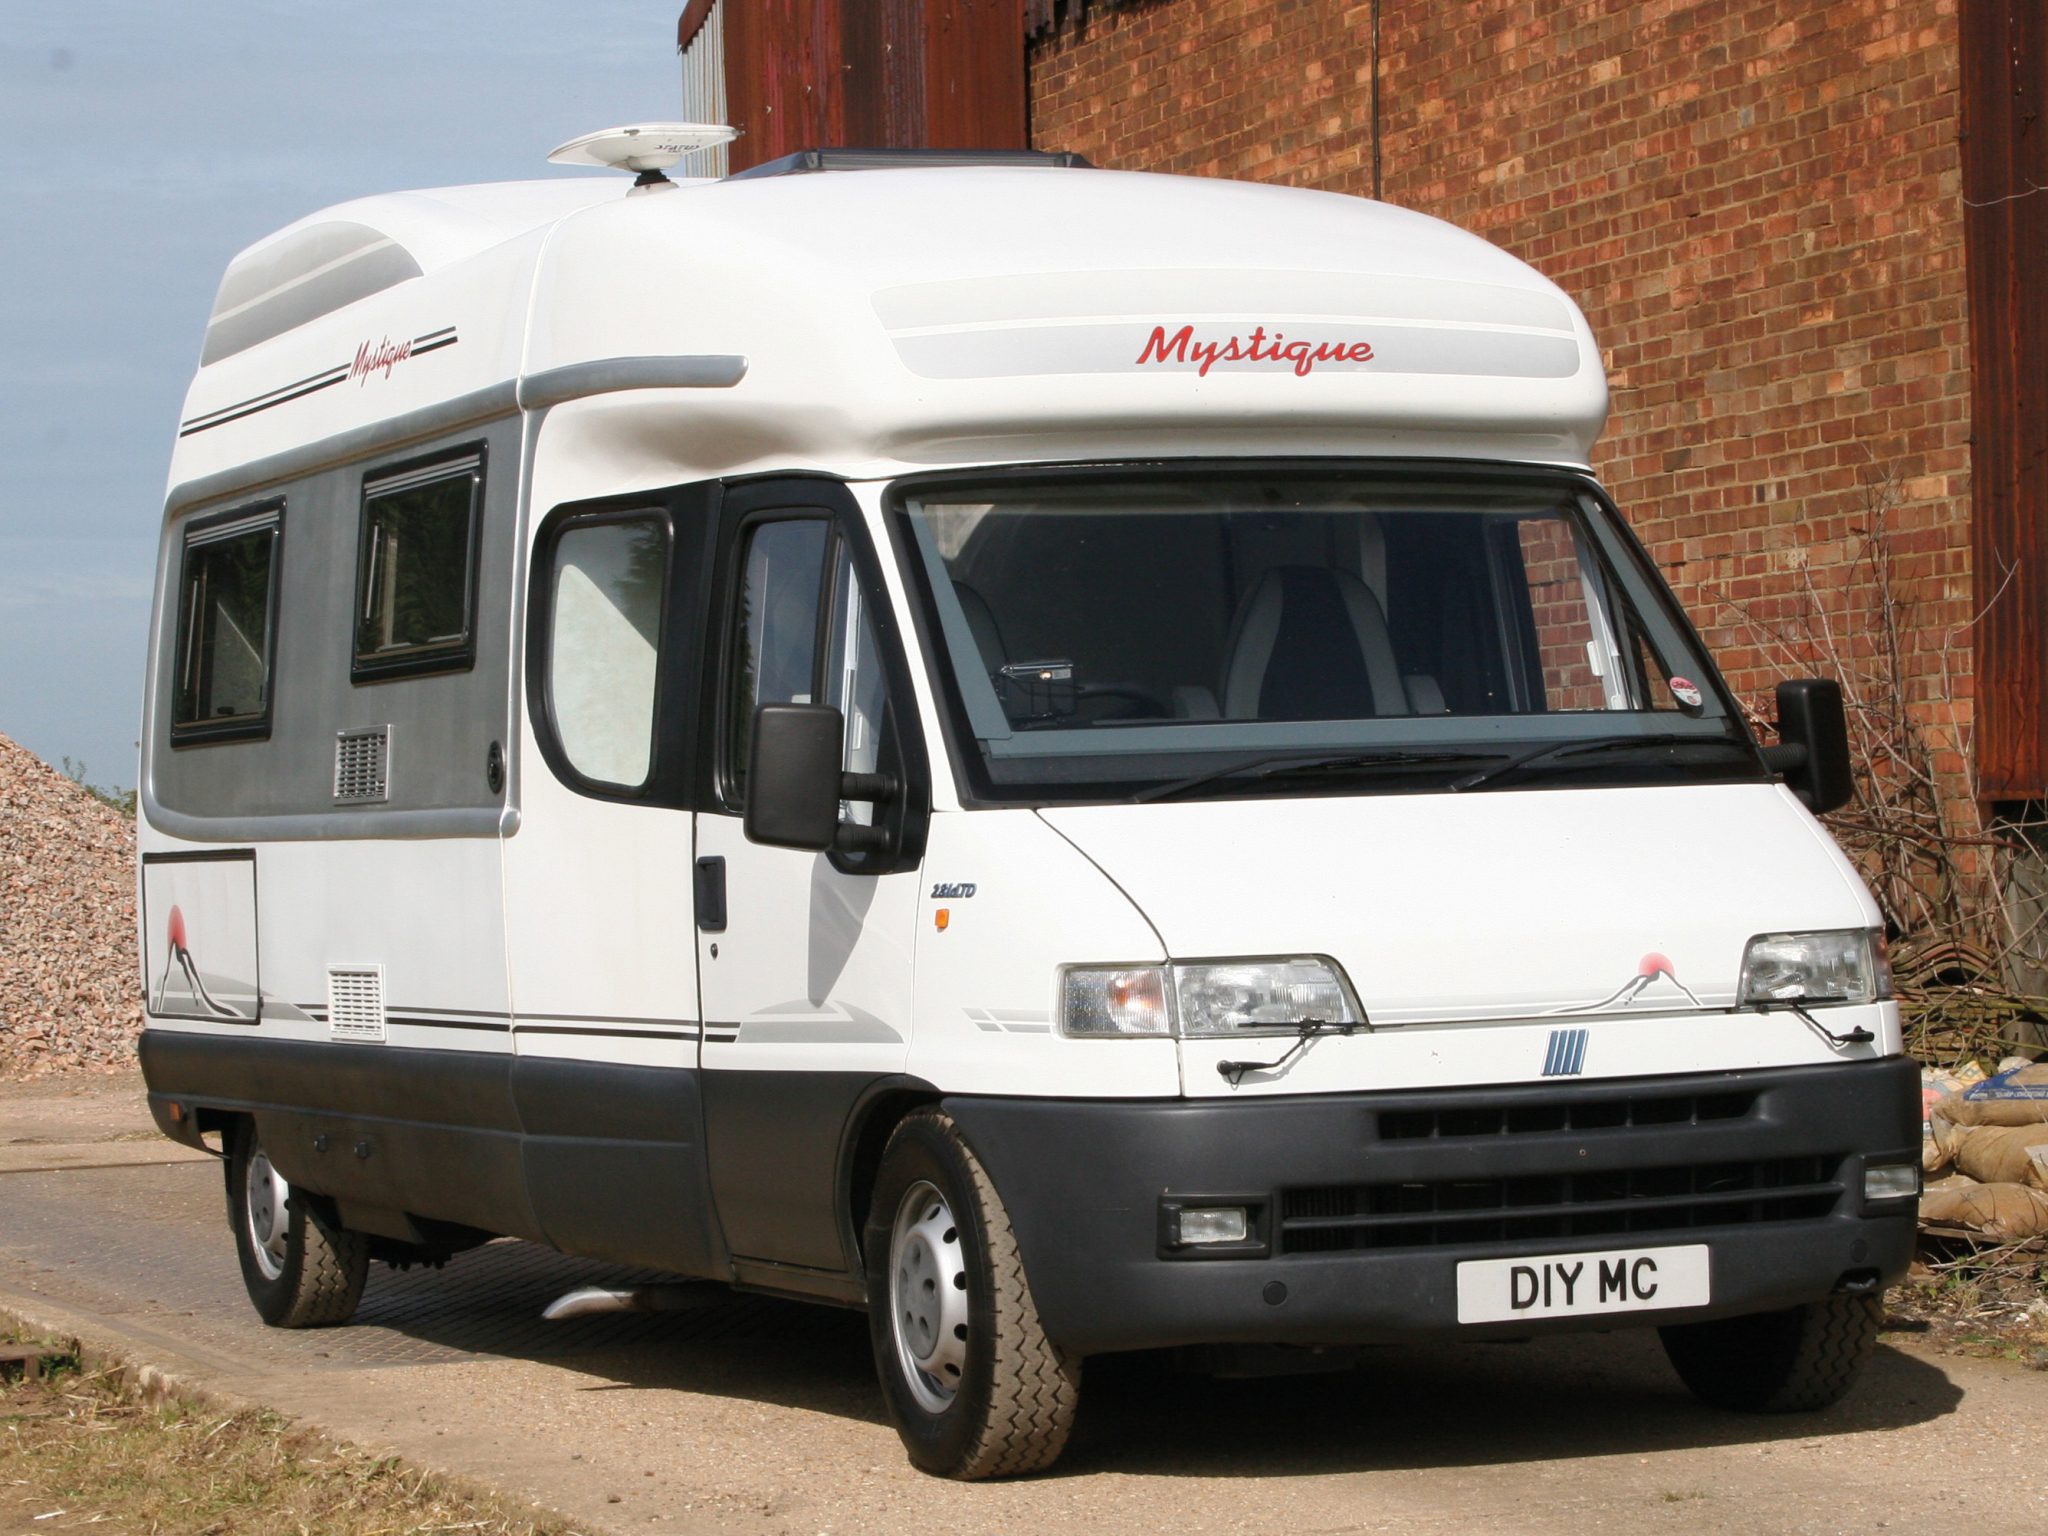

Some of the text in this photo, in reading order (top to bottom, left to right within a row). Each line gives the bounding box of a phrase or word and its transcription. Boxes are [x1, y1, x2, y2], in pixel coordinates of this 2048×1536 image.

[348, 334, 412, 388] Mystique
[1136, 325, 1374, 377] Mystique
[1510, 1257, 1658, 1310] DIY MC
